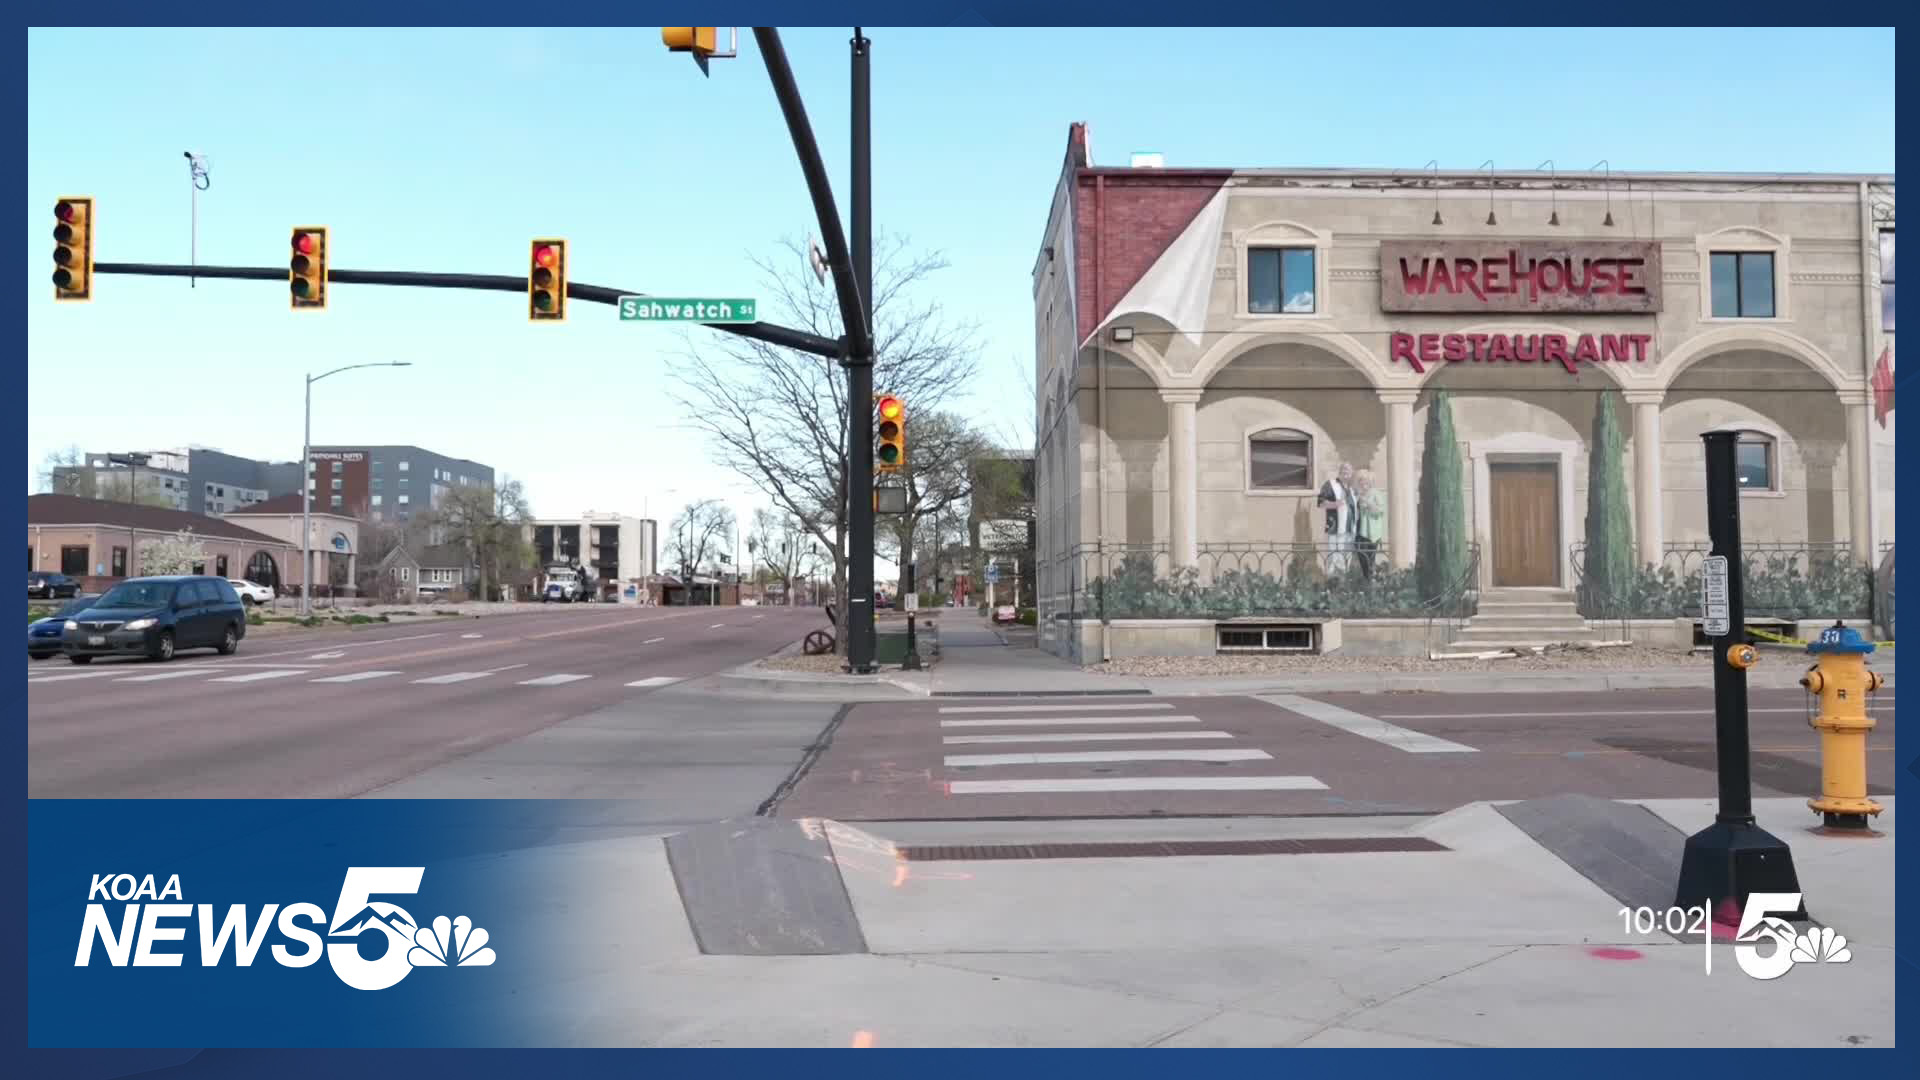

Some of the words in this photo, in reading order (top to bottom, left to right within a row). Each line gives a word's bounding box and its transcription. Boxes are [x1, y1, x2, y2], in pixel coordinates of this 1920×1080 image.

[1399, 250, 1646, 302] WAREHOUSE
[622, 301, 732, 318] Sahwatch
[1390, 332, 1652, 373] RESTAURANT
